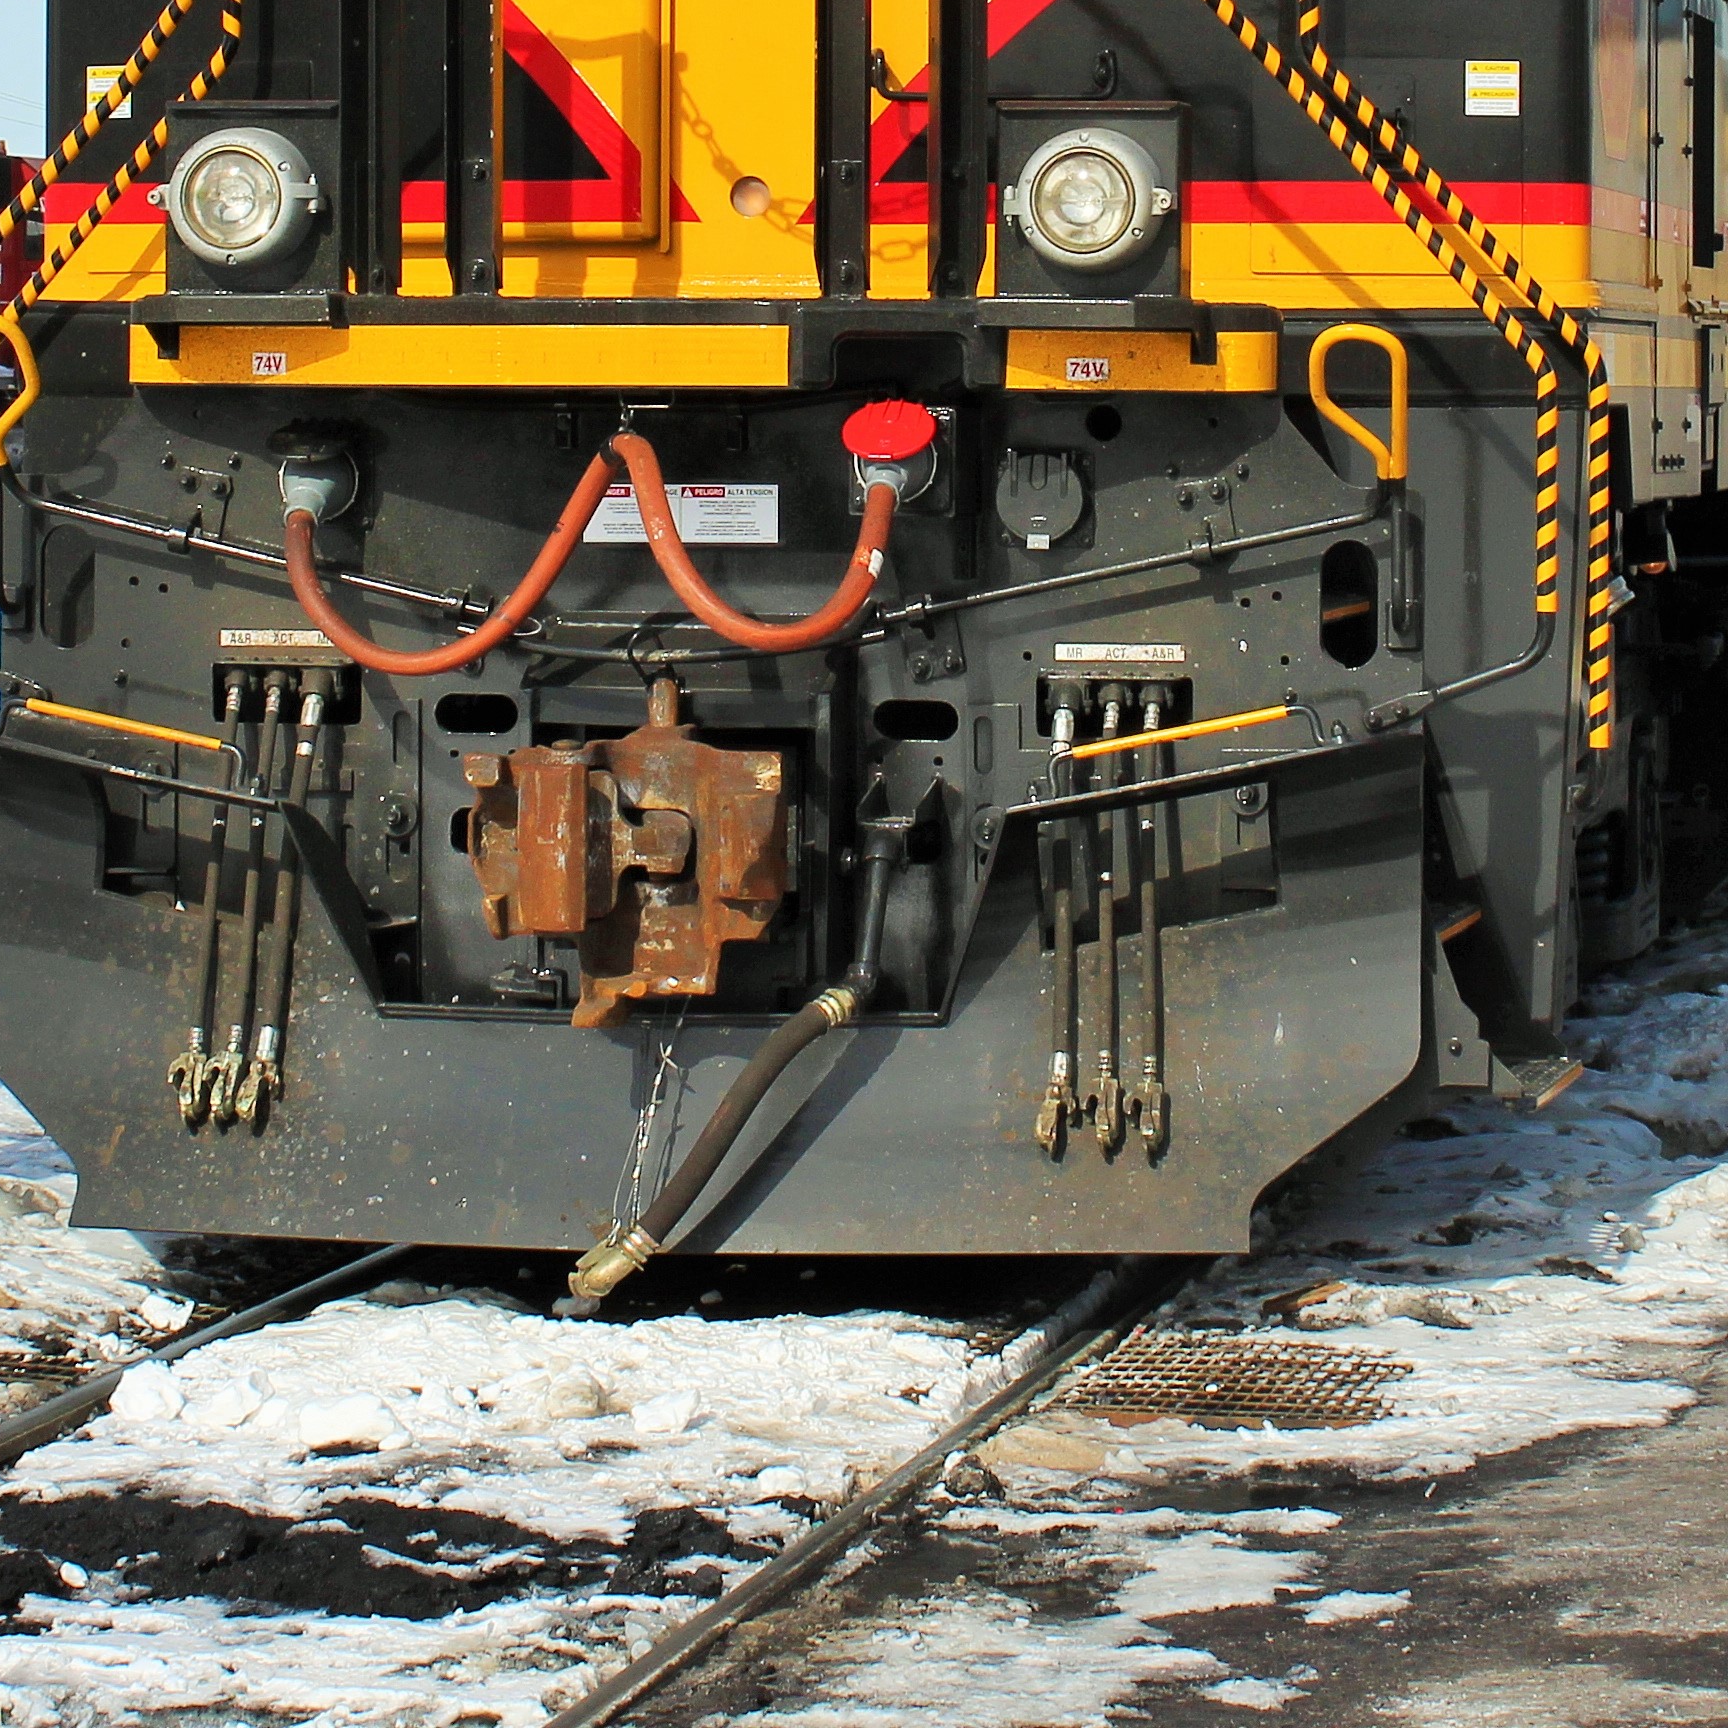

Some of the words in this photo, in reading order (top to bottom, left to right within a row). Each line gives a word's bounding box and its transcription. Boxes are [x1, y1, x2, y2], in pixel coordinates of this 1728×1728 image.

[255, 356, 282, 372] 74V
[1070, 362, 1104, 378] 74V
[694, 487, 724, 496] PELIGRO
[746, 488, 774, 496] TENSION
[230, 633, 252, 644] A&R
[1066, 647, 1083, 658] MR
[1152, 648, 1175, 659] A&R
